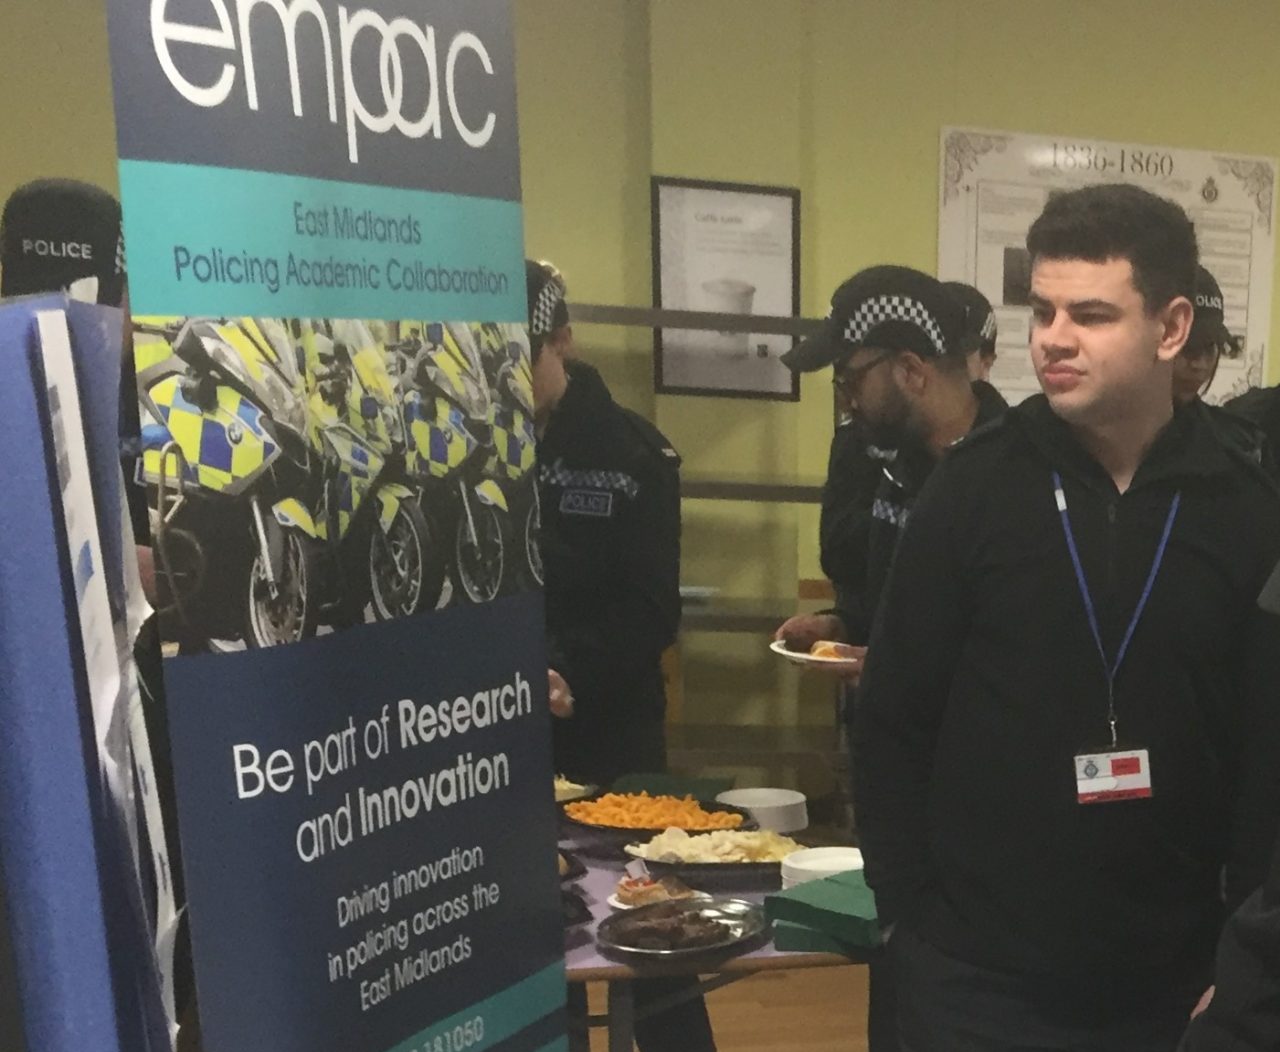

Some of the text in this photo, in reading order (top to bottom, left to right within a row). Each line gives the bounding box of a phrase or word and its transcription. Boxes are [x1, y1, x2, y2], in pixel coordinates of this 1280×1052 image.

[150, 0, 497, 163] empac
[1051, 142, 1174, 177] 1836-1860
[22, 238, 93, 260] POLICE
[294, 201, 422, 245] East Midlands
[174, 245, 509, 295] Policing Academic Collaboration
[232, 671, 531, 799] Be part of Research
[296, 751, 511, 863] and Innovation
[337, 846, 484, 928] Driving innovation
[328, 880, 500, 983] in policing across the
[360, 935, 473, 1012] East Midlands
